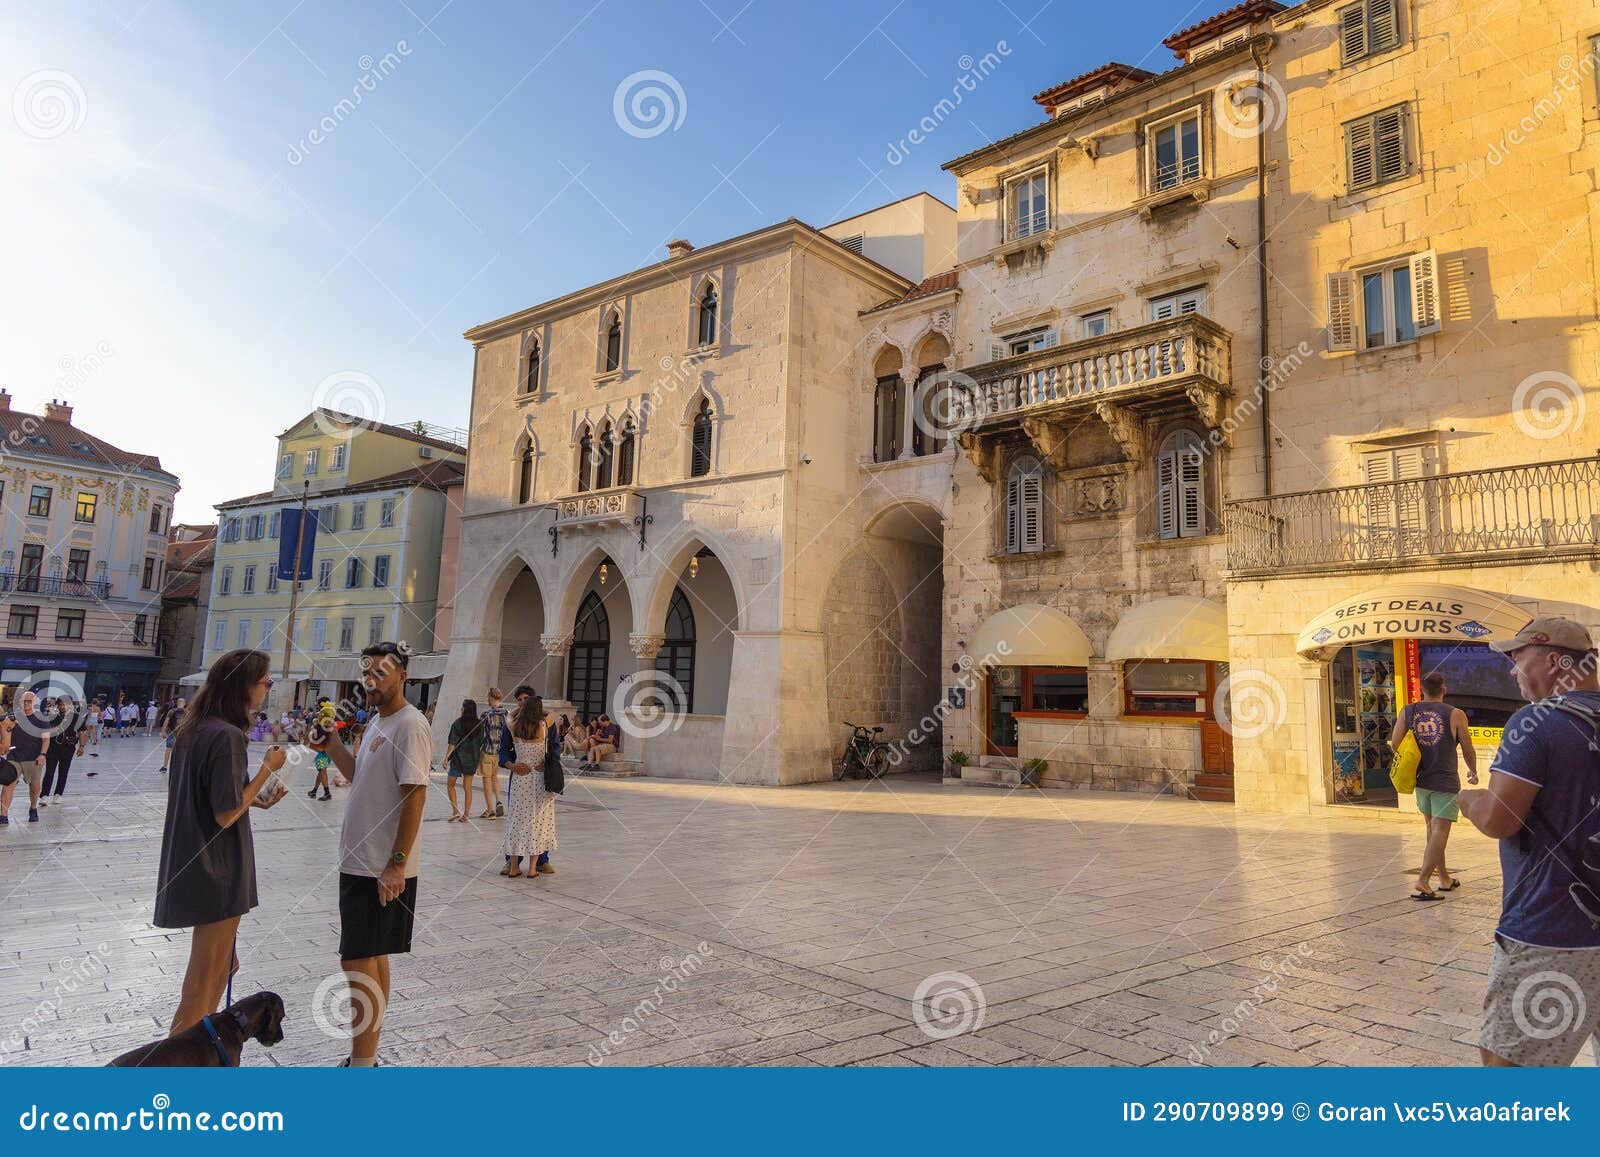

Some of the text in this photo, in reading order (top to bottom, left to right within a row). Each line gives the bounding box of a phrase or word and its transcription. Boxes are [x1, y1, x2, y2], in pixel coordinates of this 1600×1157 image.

[1388, 600, 1463, 615] DEALS
[1338, 622, 1366, 639] ON
[1373, 619, 1452, 634] TOURS
